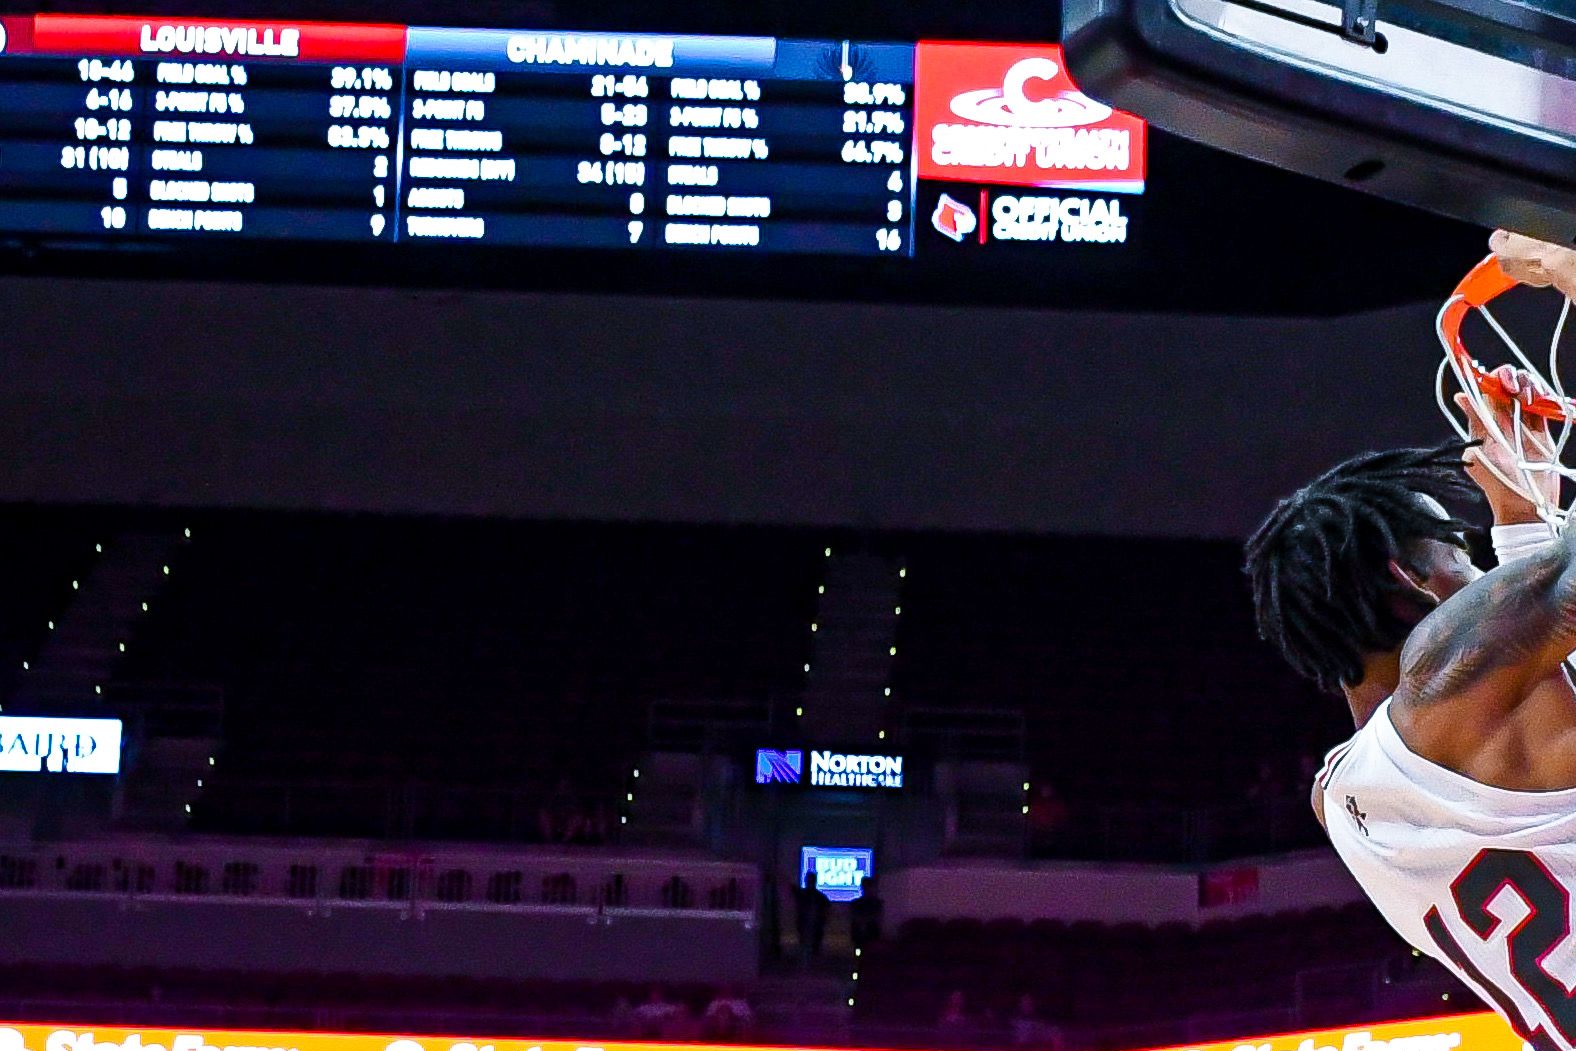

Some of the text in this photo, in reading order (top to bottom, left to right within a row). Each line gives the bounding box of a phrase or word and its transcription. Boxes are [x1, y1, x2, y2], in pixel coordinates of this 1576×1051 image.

[141, 25, 299, 56] LOUISVILLE
[507, 37, 676, 67] CHAMINADE
[992, 196, 1128, 224] OFFICIAL
[811, 751, 902, 774] NORTON
